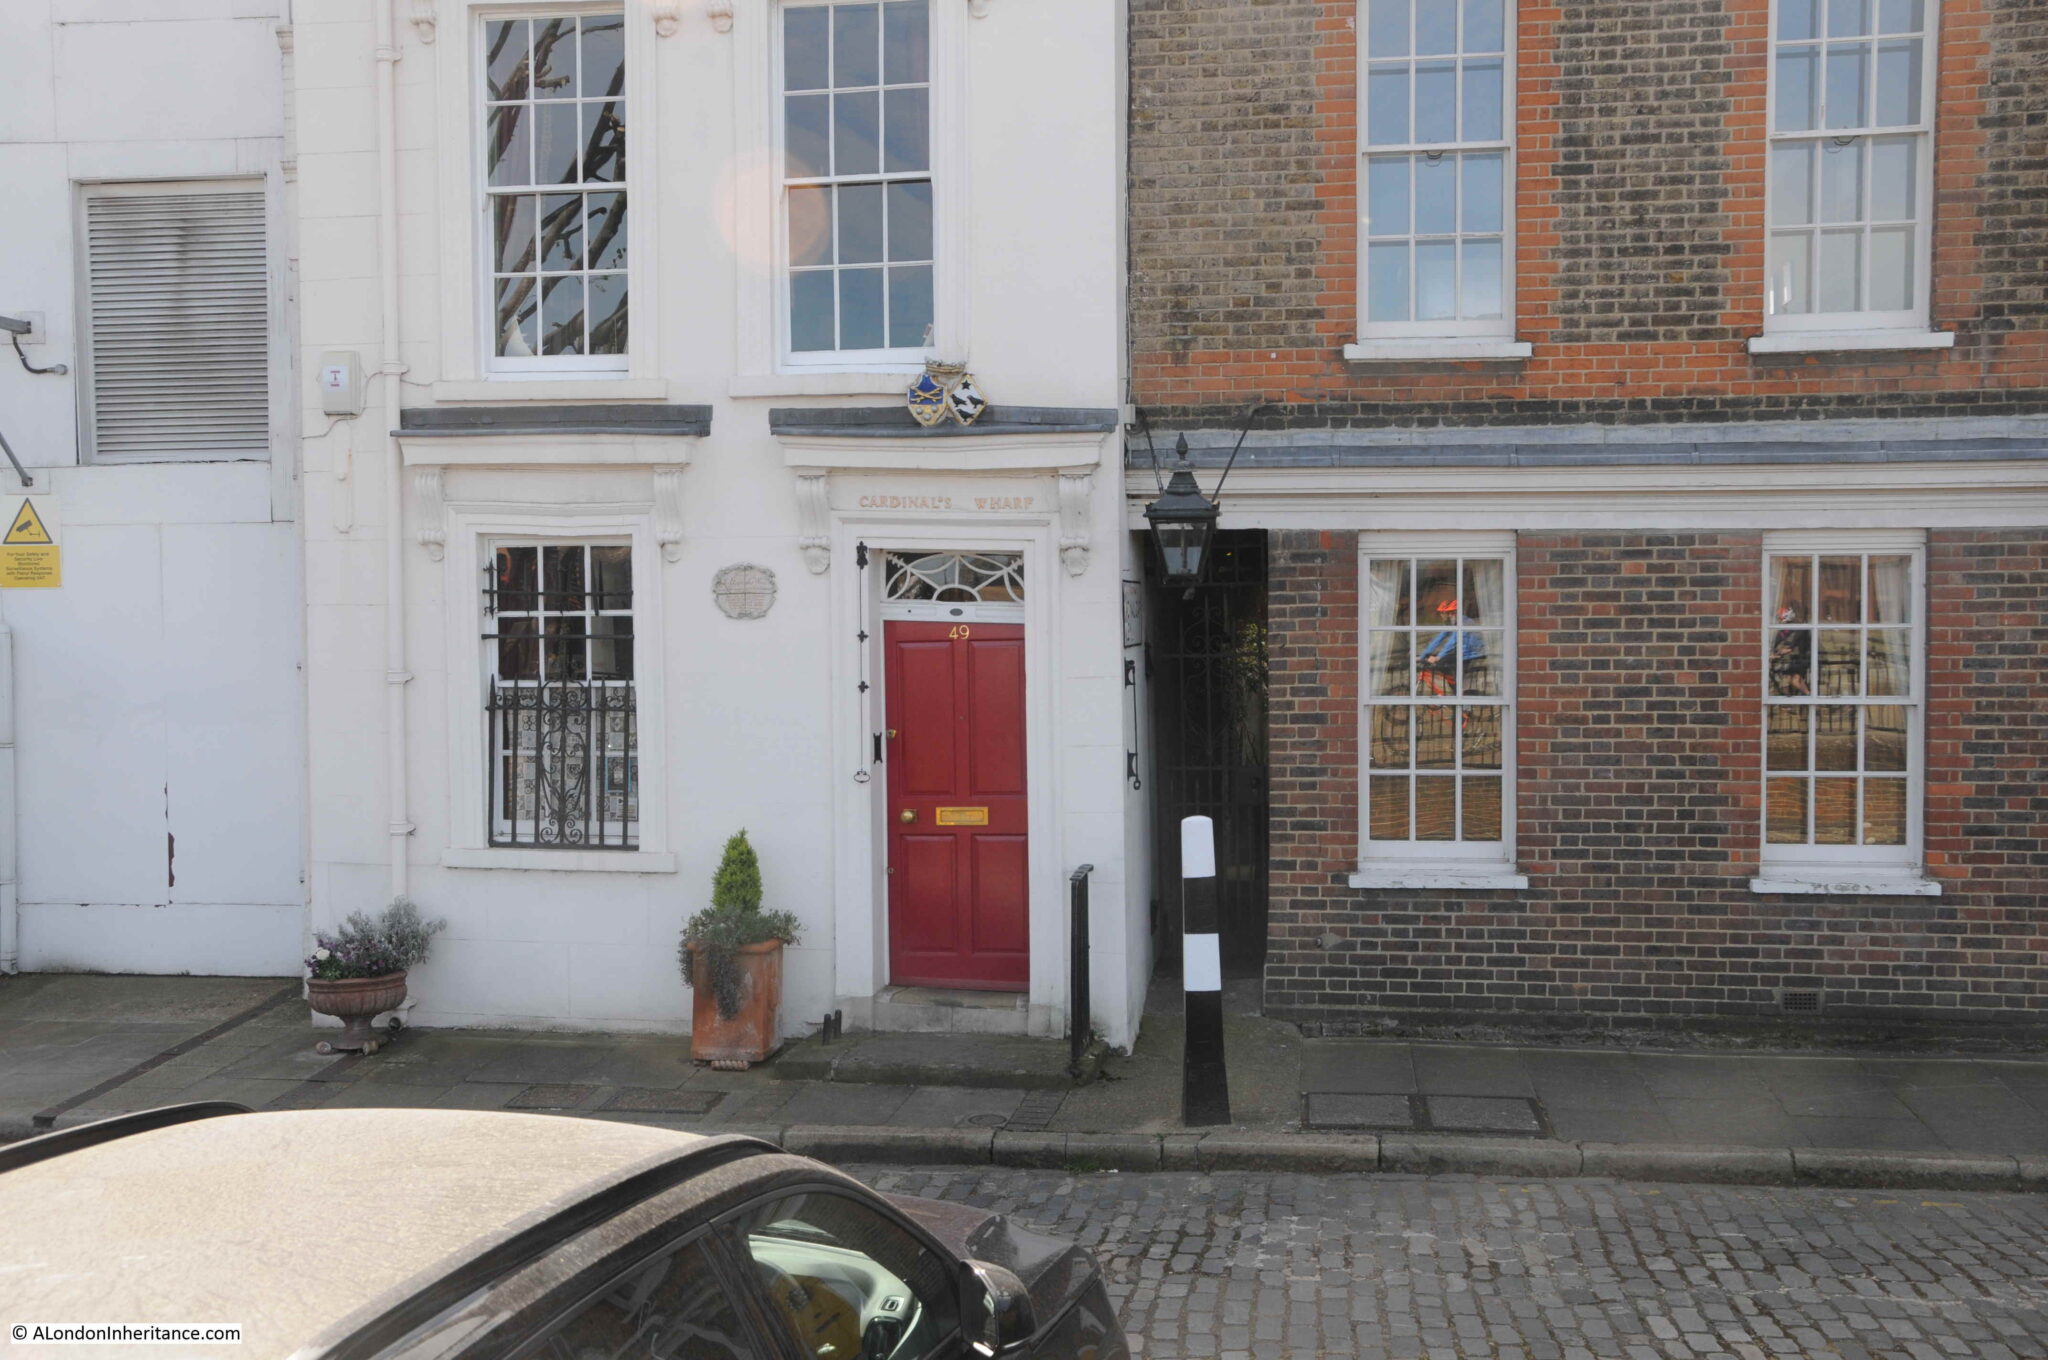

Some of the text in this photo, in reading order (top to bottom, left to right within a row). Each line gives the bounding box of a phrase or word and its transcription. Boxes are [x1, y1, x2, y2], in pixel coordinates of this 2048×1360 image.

[858, 495, 1034, 510] CARDINAL'S WHARF
[949, 624, 970, 640] 49
